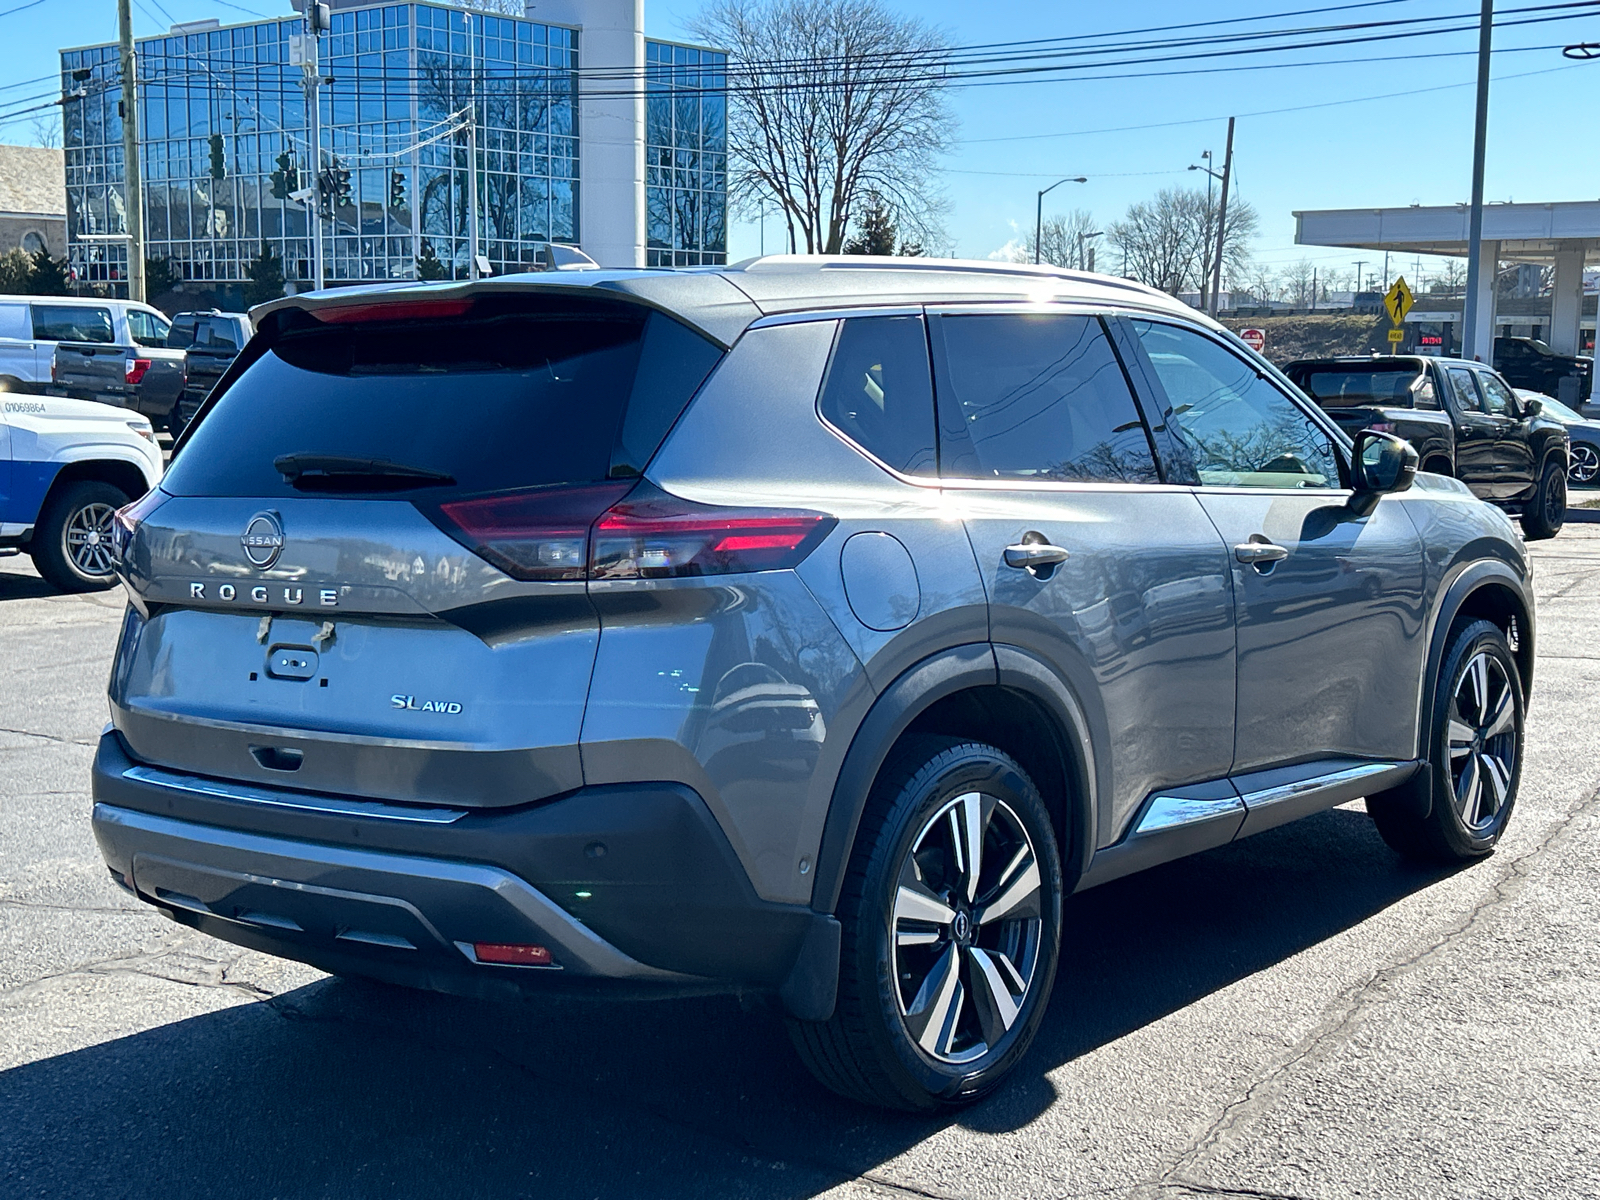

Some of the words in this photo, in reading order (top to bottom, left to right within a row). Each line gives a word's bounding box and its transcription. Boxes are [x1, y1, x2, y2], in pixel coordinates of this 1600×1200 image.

[240, 536, 281, 545] NISSAN
[189, 582, 339, 607] ROGUE
[391, 694, 421, 711] SL
[421, 701, 463, 714] AWD
